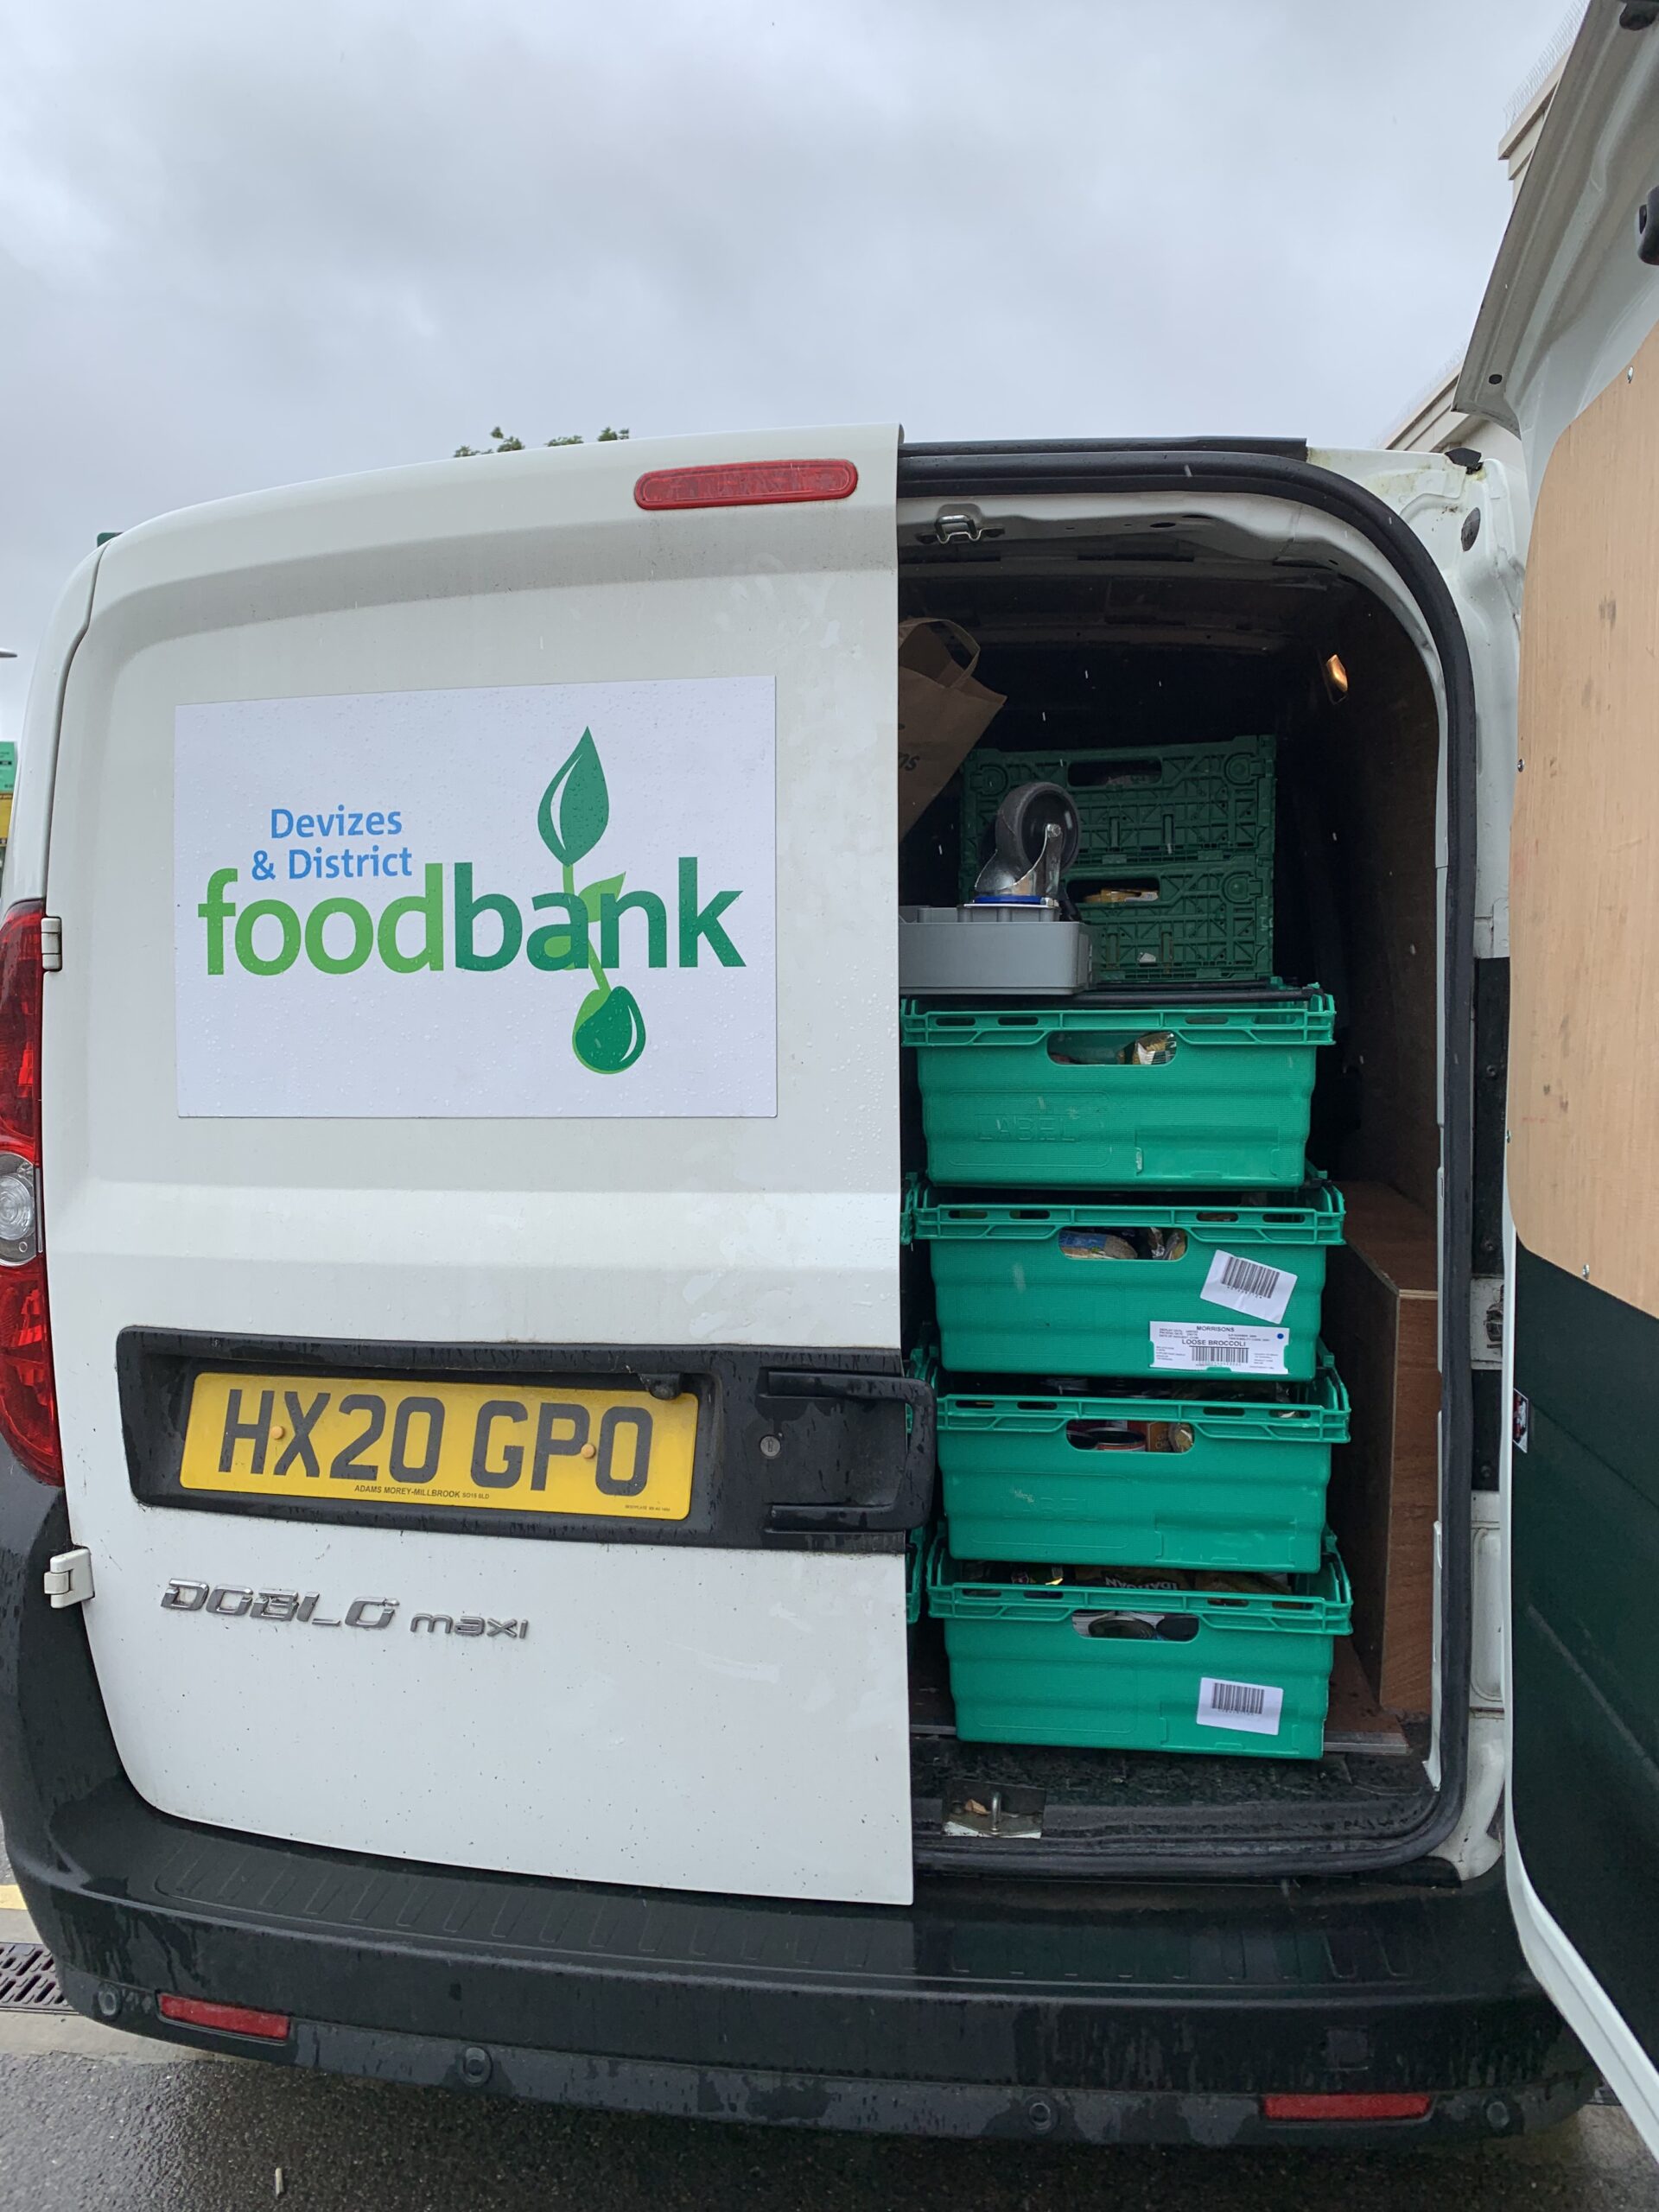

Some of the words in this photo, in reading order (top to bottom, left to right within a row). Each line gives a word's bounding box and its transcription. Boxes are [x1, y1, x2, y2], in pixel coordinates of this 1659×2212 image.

[270, 804, 403, 840] Devizes
[251, 849, 276, 881] &
[288, 844, 413, 880] District
[197, 855, 746, 976] foodbank
[217, 1388, 447, 1484] HX20
[471, 1399, 654, 1497] GPO
[354, 1484, 382, 1493] ADAMS
[383, 1487, 461, 1498] MOREY-MILLBROOK
[410, 1611, 530, 1639] maxi
